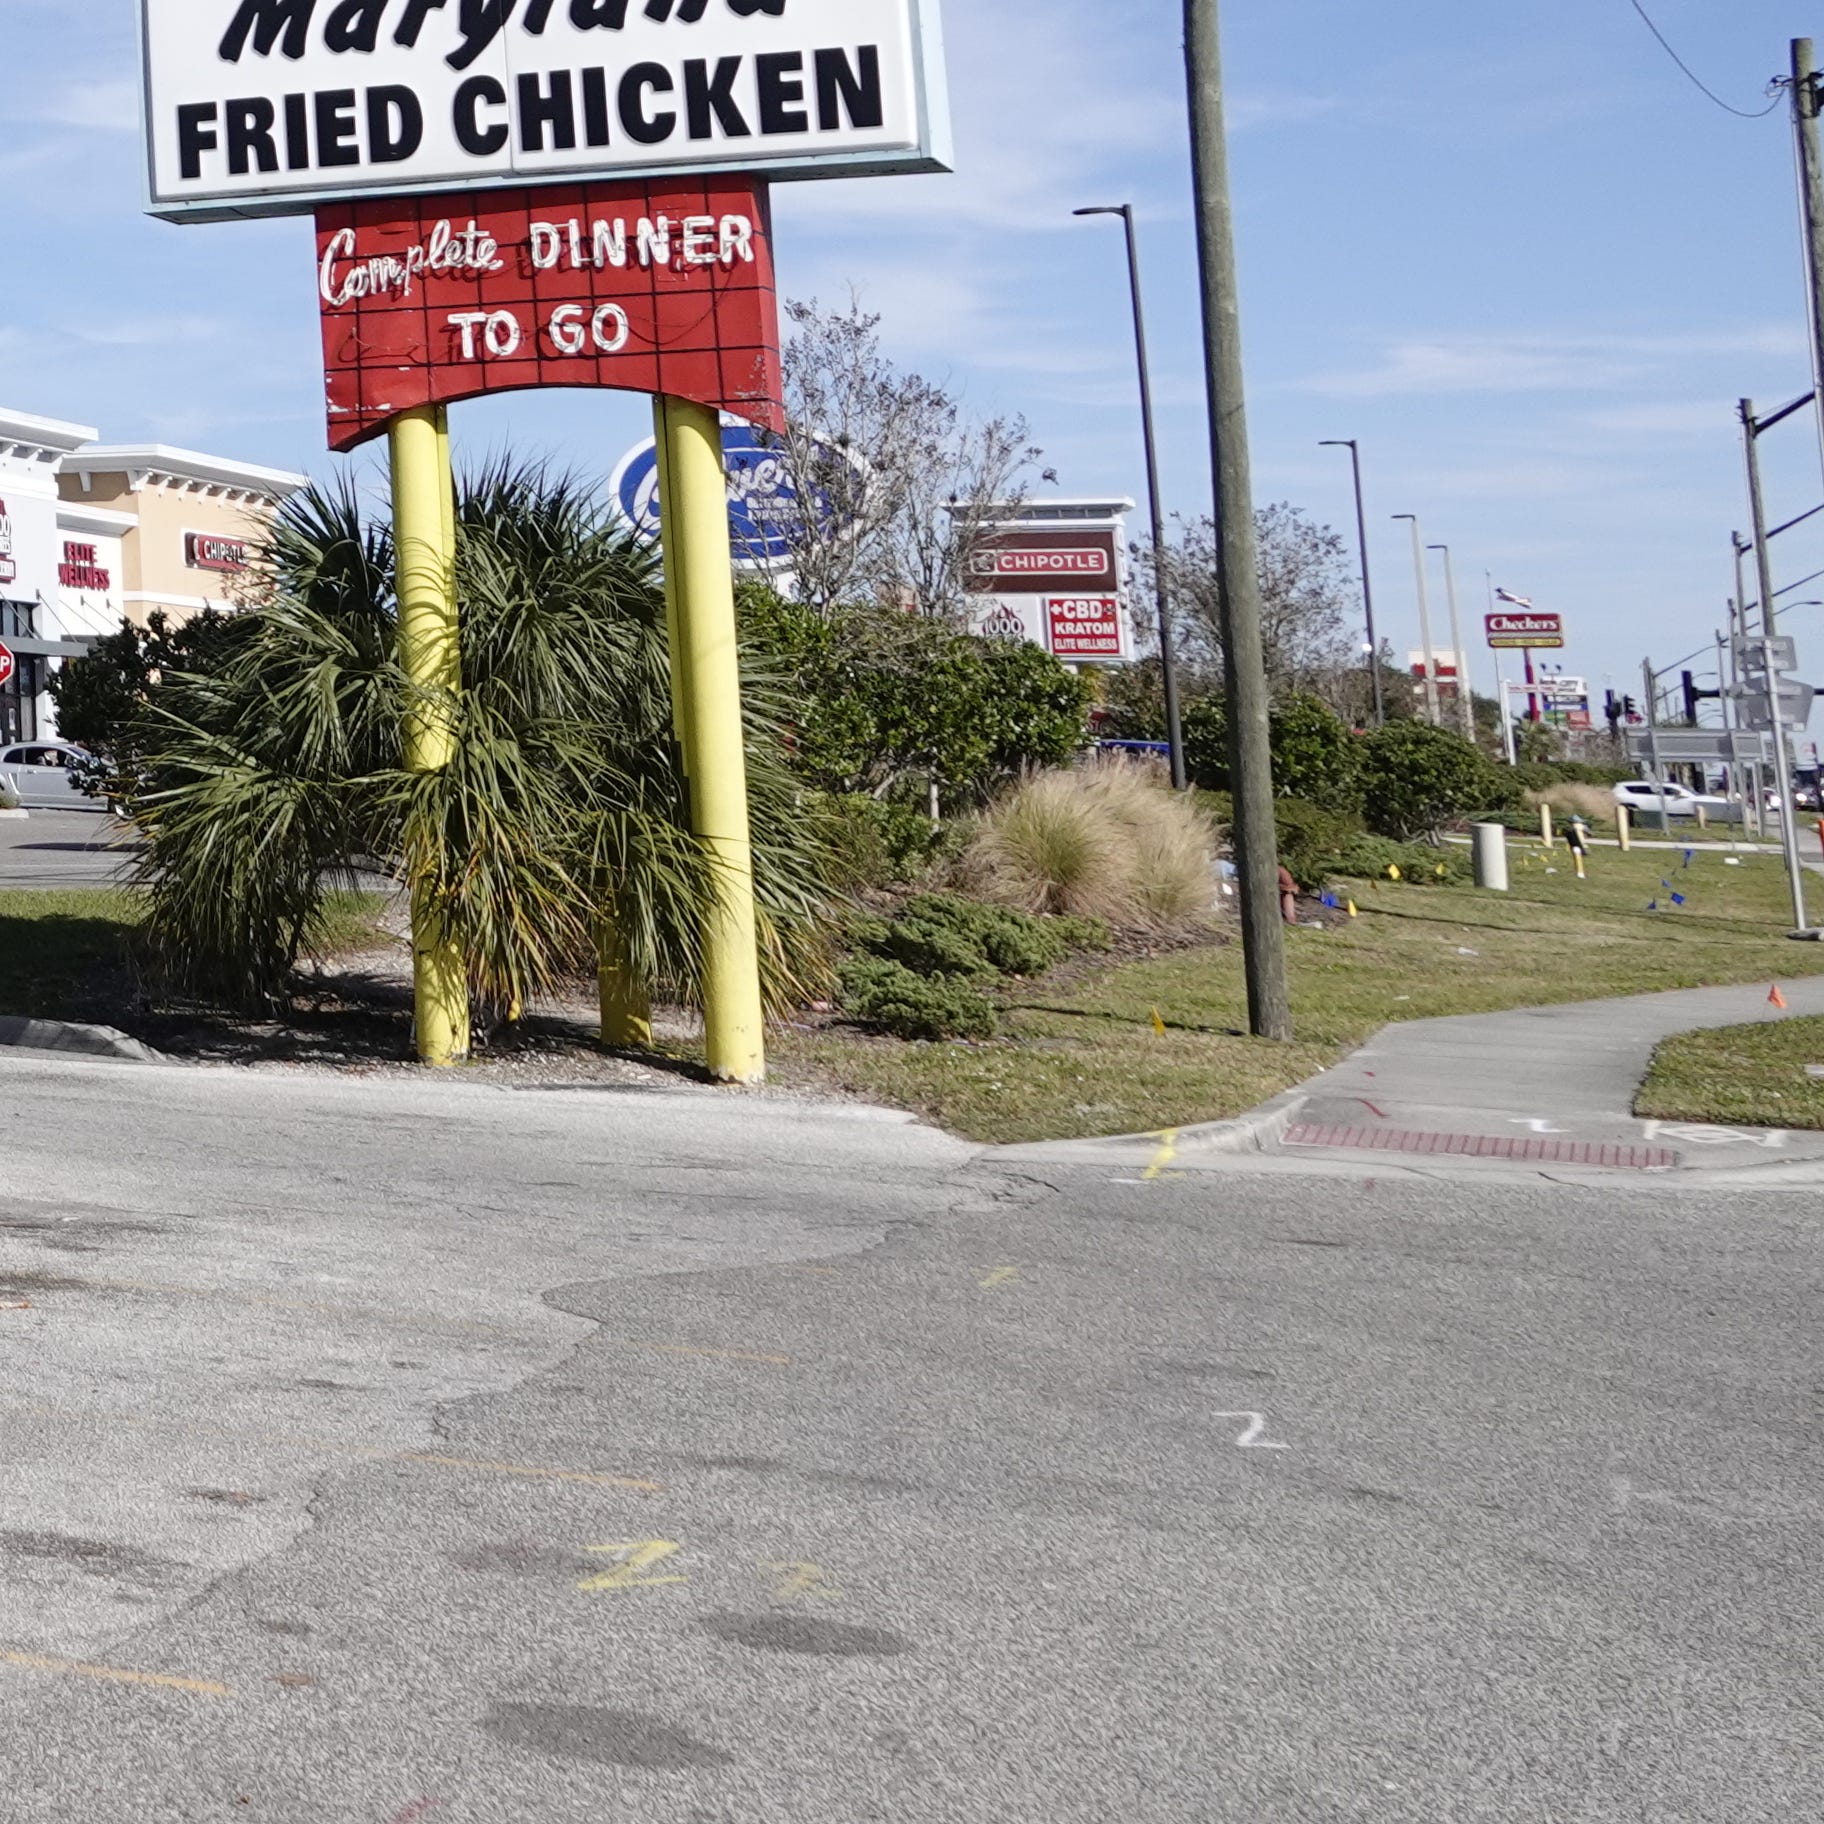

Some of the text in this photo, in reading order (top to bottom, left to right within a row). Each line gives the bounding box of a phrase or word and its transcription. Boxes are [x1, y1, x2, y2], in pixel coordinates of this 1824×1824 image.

[178, 46, 883, 179] FRIED CHICKEN
[318, 215, 753, 307] Complete DINNER
[448, 302, 629, 358] TO GO
[64, 541, 97, 563] ELITE
[1001, 554, 1100, 569] CHIPOTLE
[58, 563, 110, 591] WELLNESS
[1062, 600, 1103, 619] CBD
[984, 618, 1022, 634] 1000
[1055, 622, 1116, 635] KRATOM
[1489, 616, 1558, 630] Checkers
[1054, 637, 1118, 650] ELITE WELLNESS
